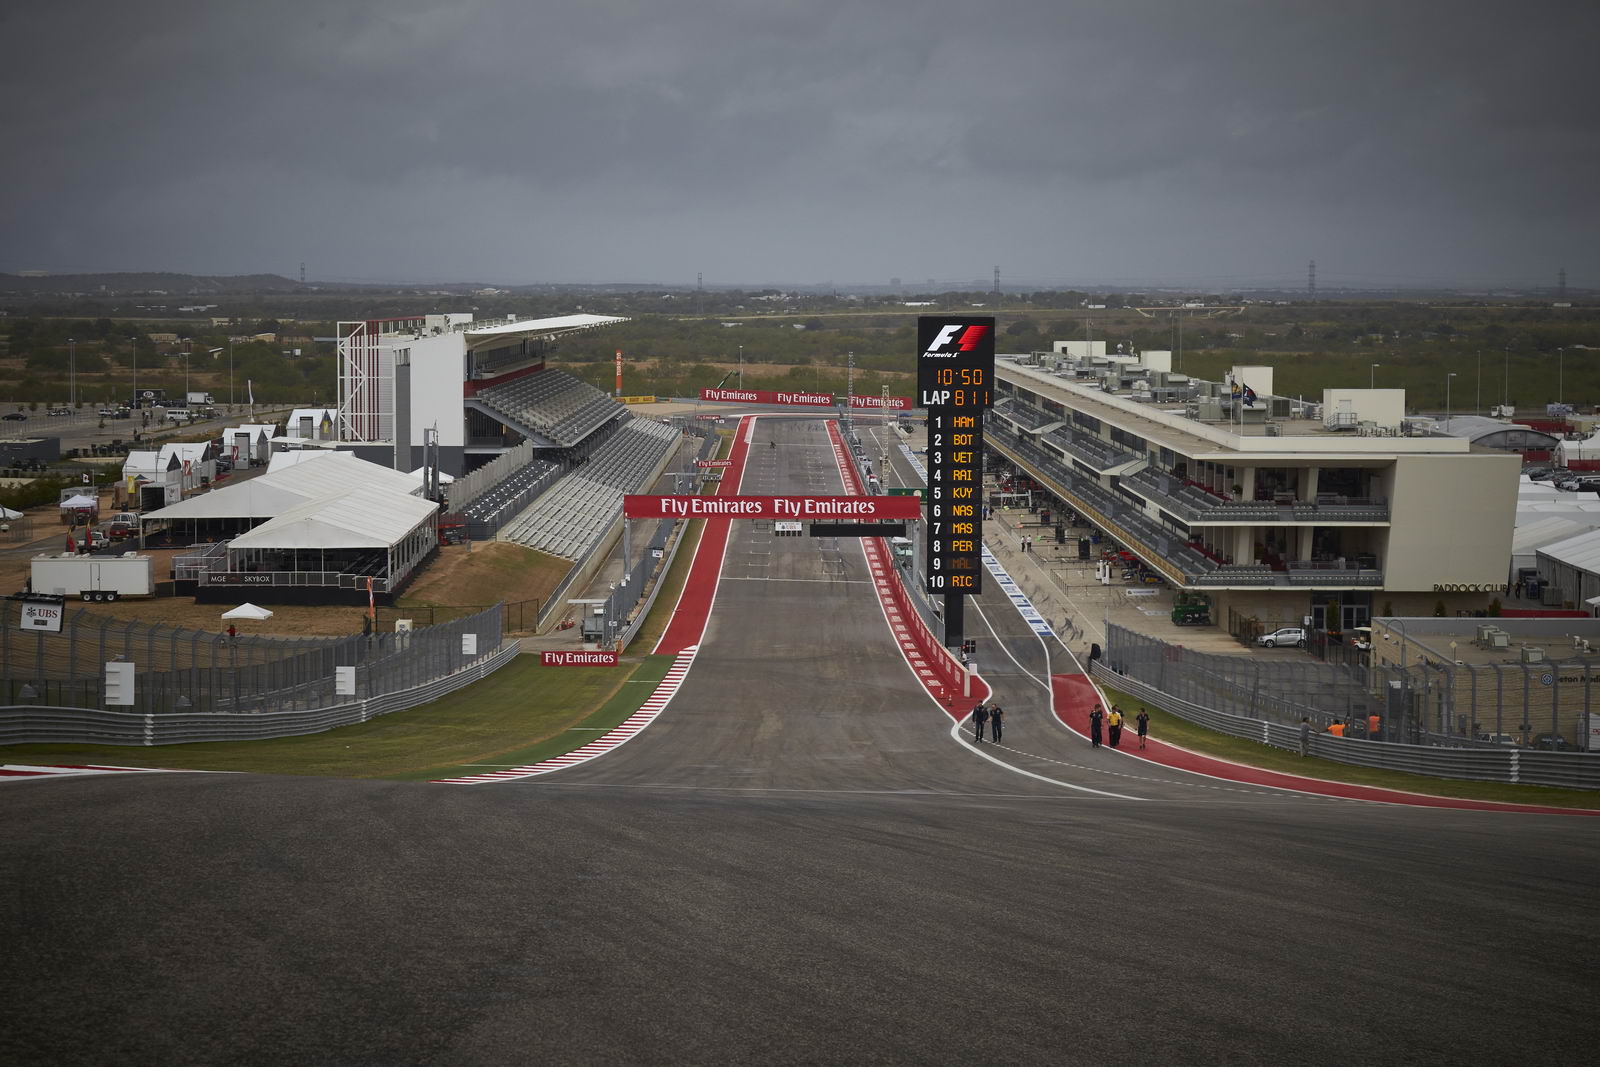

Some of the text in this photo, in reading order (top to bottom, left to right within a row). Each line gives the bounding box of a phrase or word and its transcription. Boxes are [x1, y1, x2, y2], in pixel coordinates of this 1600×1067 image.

[705, 389, 758, 401] Fly Emirates
[777, 393, 830, 404] Fly Emirates
[923, 390, 950, 405] LAP
[851, 396, 865, 407] Fly
[935, 416, 974, 428] 1 HAM
[934, 434, 973, 446] 2 BOT
[934, 452, 973, 464] 3 VET
[934, 469, 972, 481] 4 RAI
[934, 487, 973, 499] 5 KVY
[661, 498, 762, 516] Fly Emirates
[774, 499, 875, 516] Fly Emirates
[933, 504, 973, 517] 6 NAS
[933, 522, 973, 534] 7 MAS
[933, 540, 973, 552] 8 PER
[933, 558, 941, 570] 9
[211, 575, 270, 583] MGE SKYBOX
[930, 575, 973, 588] 10 RIC
[1433, 583, 1481, 592] PADDOCK
[38, 608, 58, 619] UBS
[545, 652, 614, 665] Fly Emirates
[1556, 675, 1578, 683] eton
